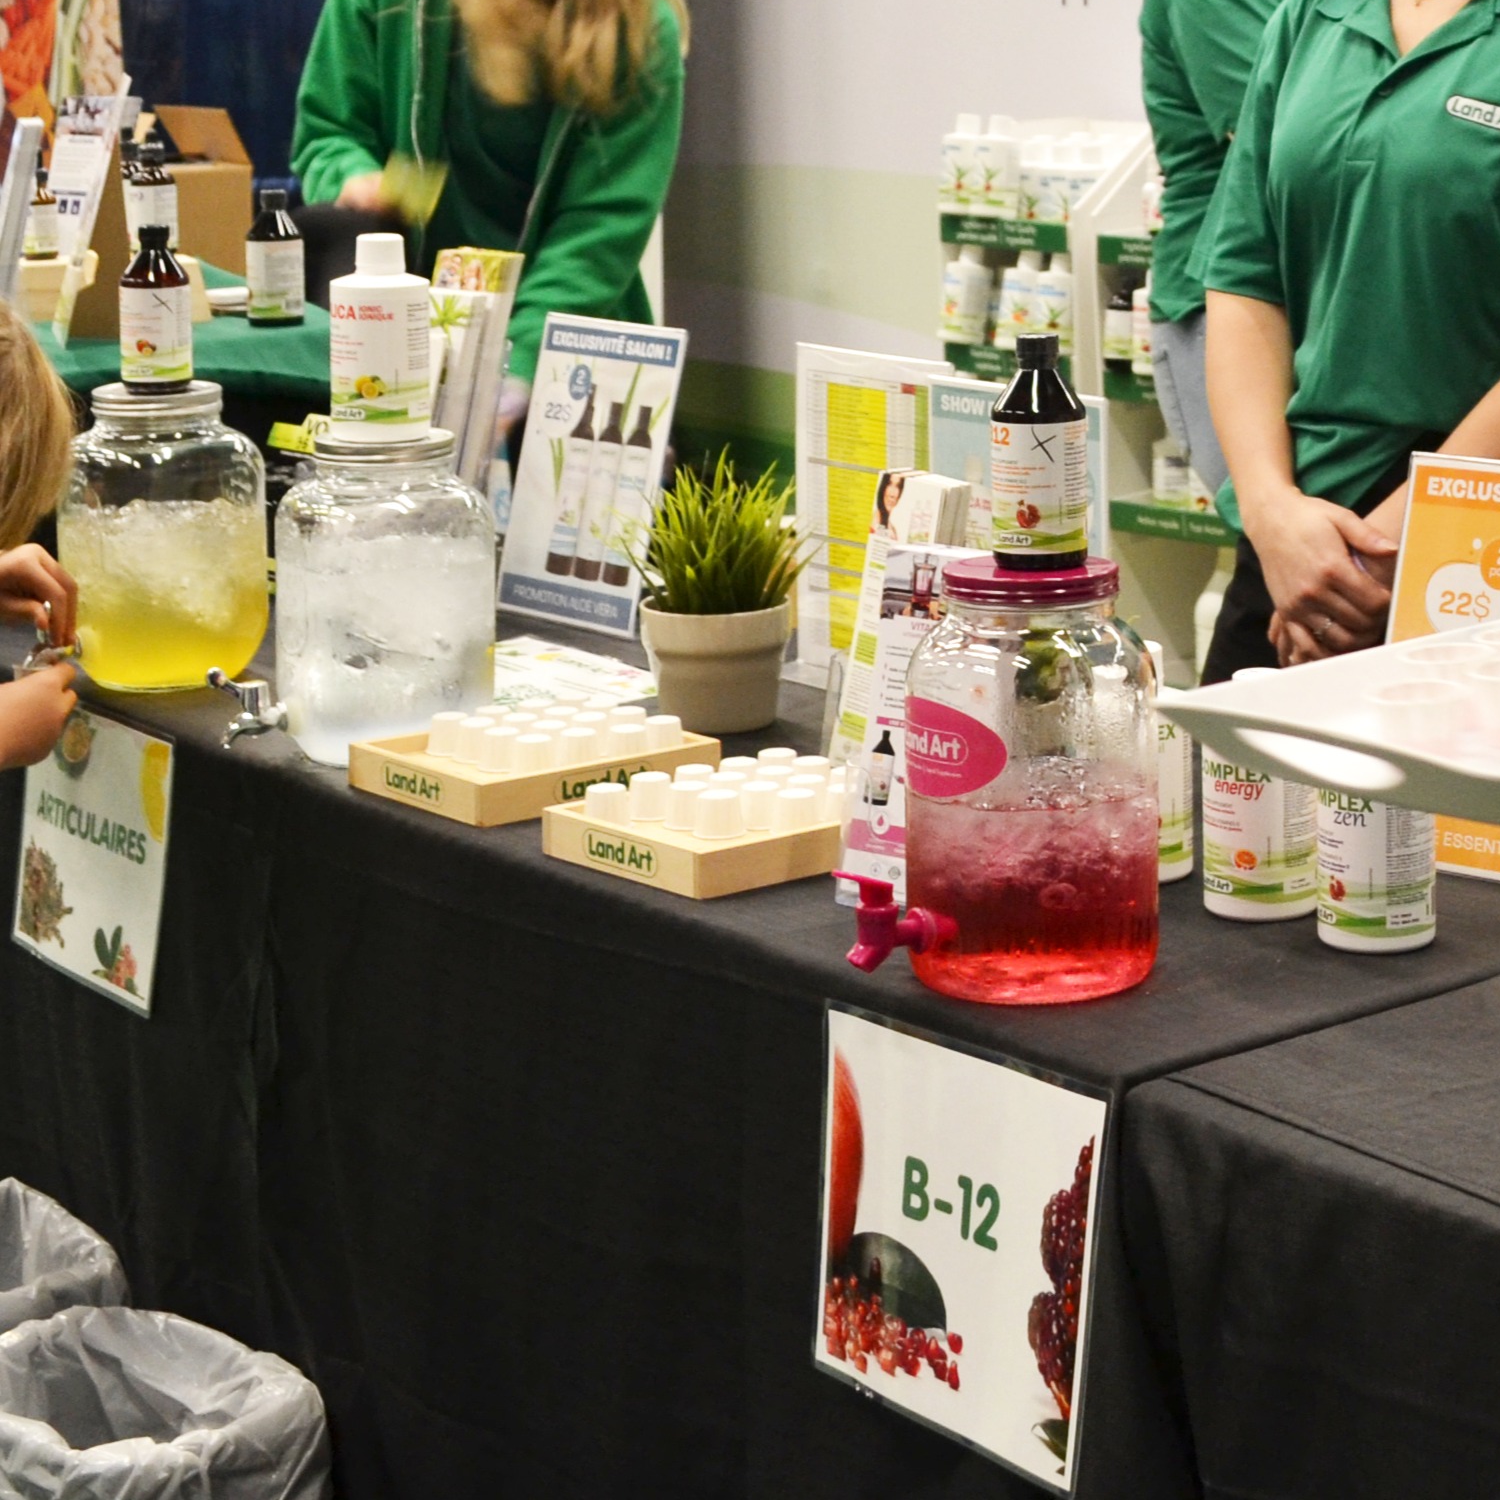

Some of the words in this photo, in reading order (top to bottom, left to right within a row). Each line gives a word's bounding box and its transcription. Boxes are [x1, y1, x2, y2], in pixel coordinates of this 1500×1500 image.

[1451, 98, 1497, 123] Land
[551, 330, 626, 356] EXCLUSIVITÉ
[626, 340, 665, 360] SALON
[576, 369, 586, 385] 2
[940, 394, 985, 416] SHOW
[1438, 589, 1492, 623] 22$
[929, 734, 961, 760] Art
[385, 765, 417, 794] Land
[418, 775, 441, 801] Art
[1214, 779, 1265, 801] energy
[37, 789, 147, 865] ARTICULAIRES
[1333, 810, 1367, 828] zen
[587, 834, 624, 865] Land
[627, 843, 653, 872] Art
[901, 1155, 1001, 1252] B-12
